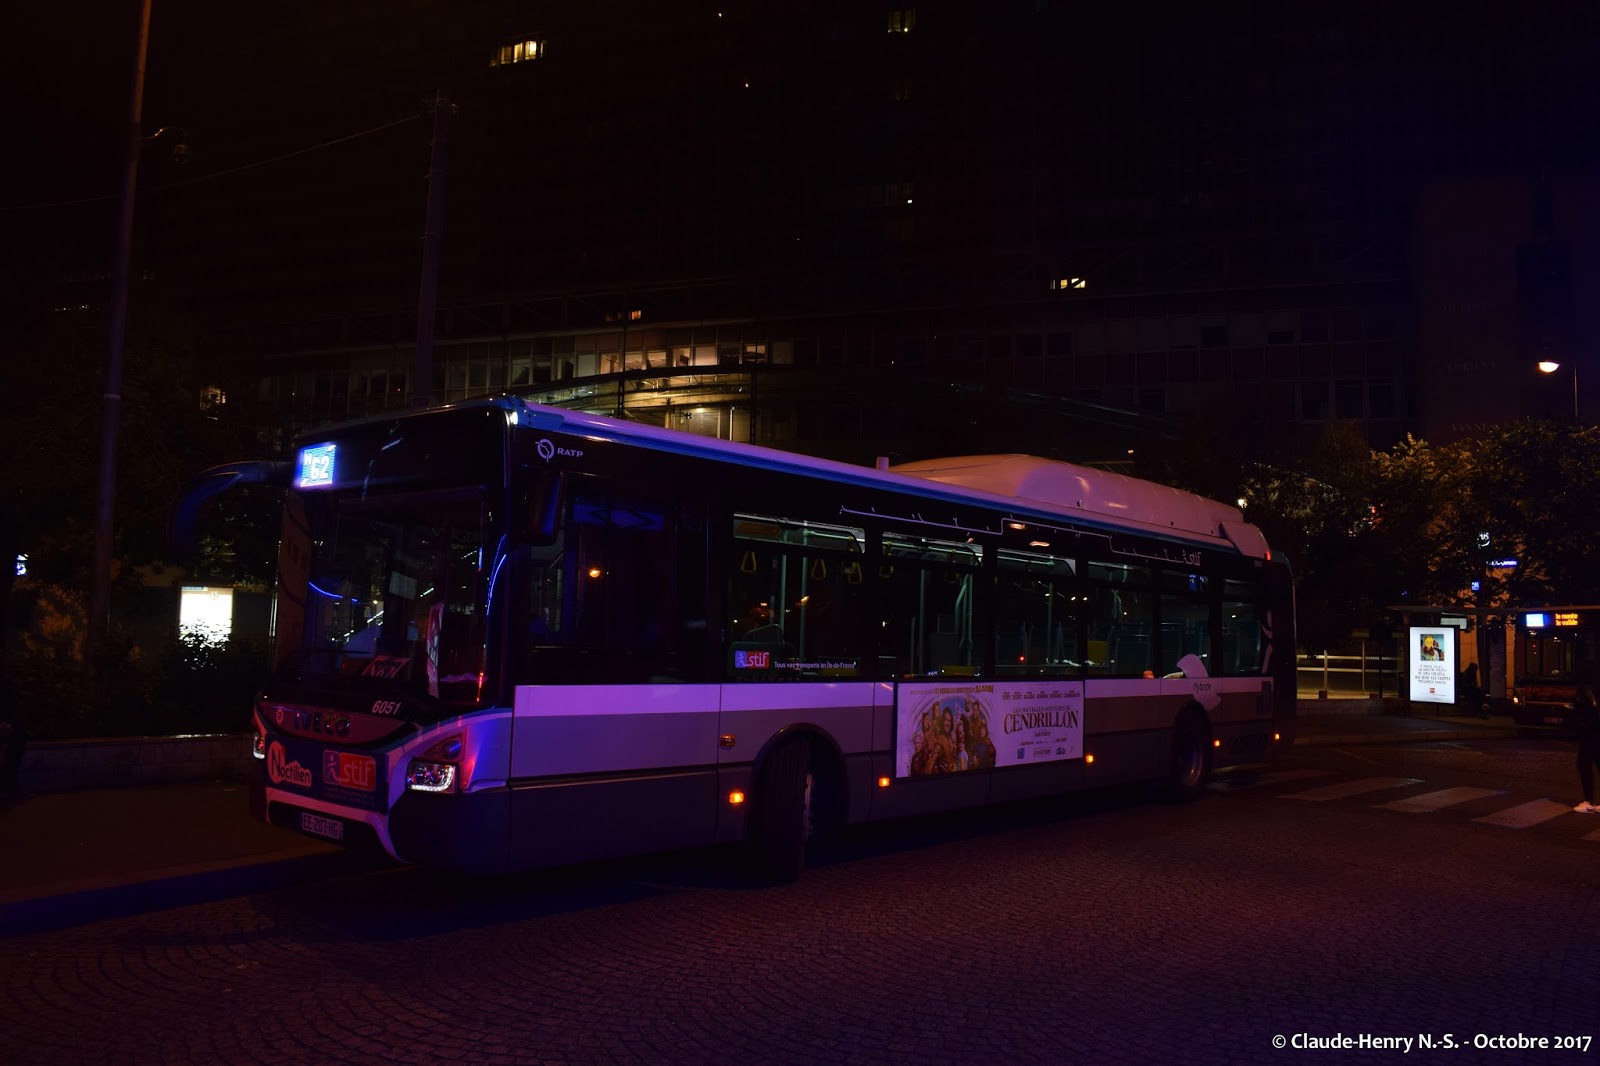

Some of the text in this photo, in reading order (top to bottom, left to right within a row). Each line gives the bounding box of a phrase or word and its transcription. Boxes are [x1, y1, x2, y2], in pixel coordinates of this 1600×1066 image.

[557, 447, 584, 458] RATP
[746, 651, 770, 667] stif
[796, 662, 820, 670] transports
[1193, 681, 1212, 694] Hybride
[371, 699, 402, 716] 6051
[1003, 710, 1079, 735] CENDRILLON
[271, 747, 311, 784] Noctilien
[342, 759, 376, 787] stif
